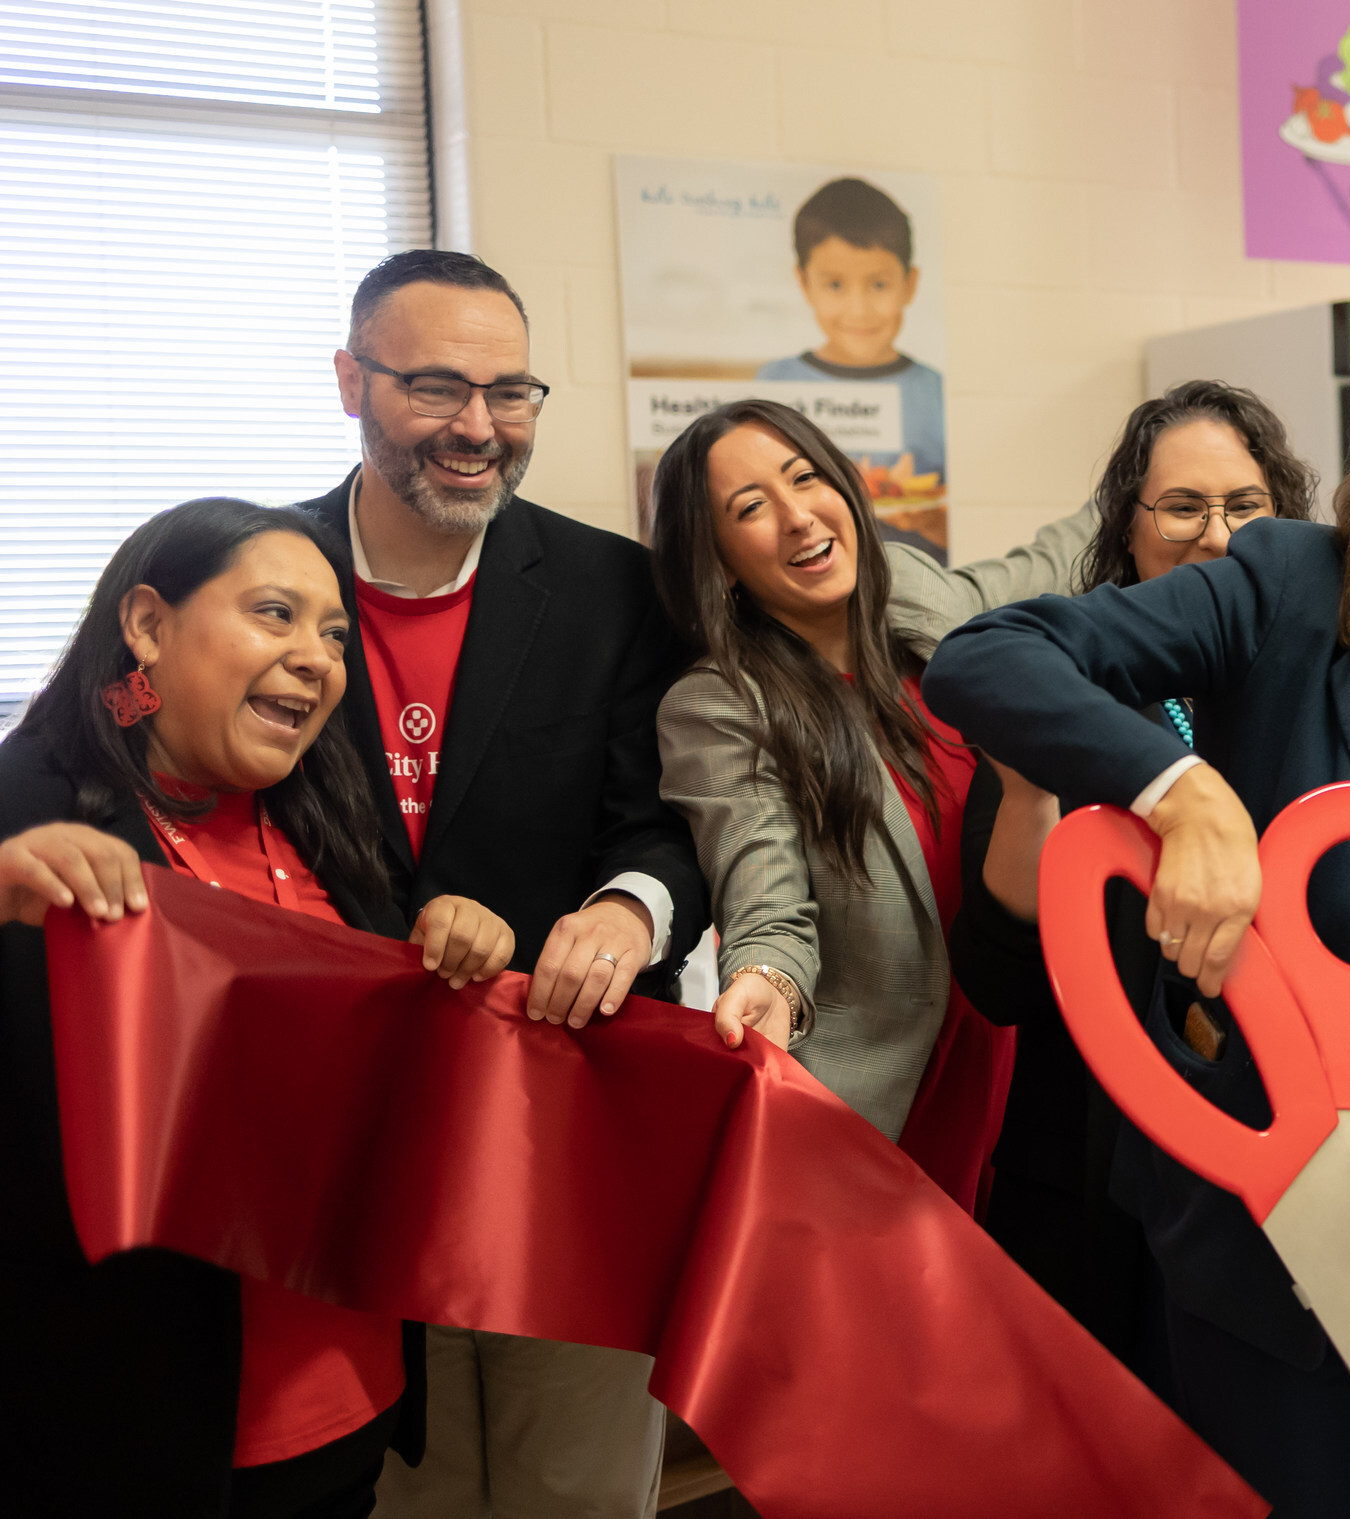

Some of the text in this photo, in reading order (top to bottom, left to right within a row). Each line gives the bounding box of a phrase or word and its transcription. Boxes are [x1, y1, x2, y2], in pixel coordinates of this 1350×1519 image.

[651, 396, 722, 414] Healt
[814, 398, 880, 416] Finder
[400, 797, 426, 814] the
